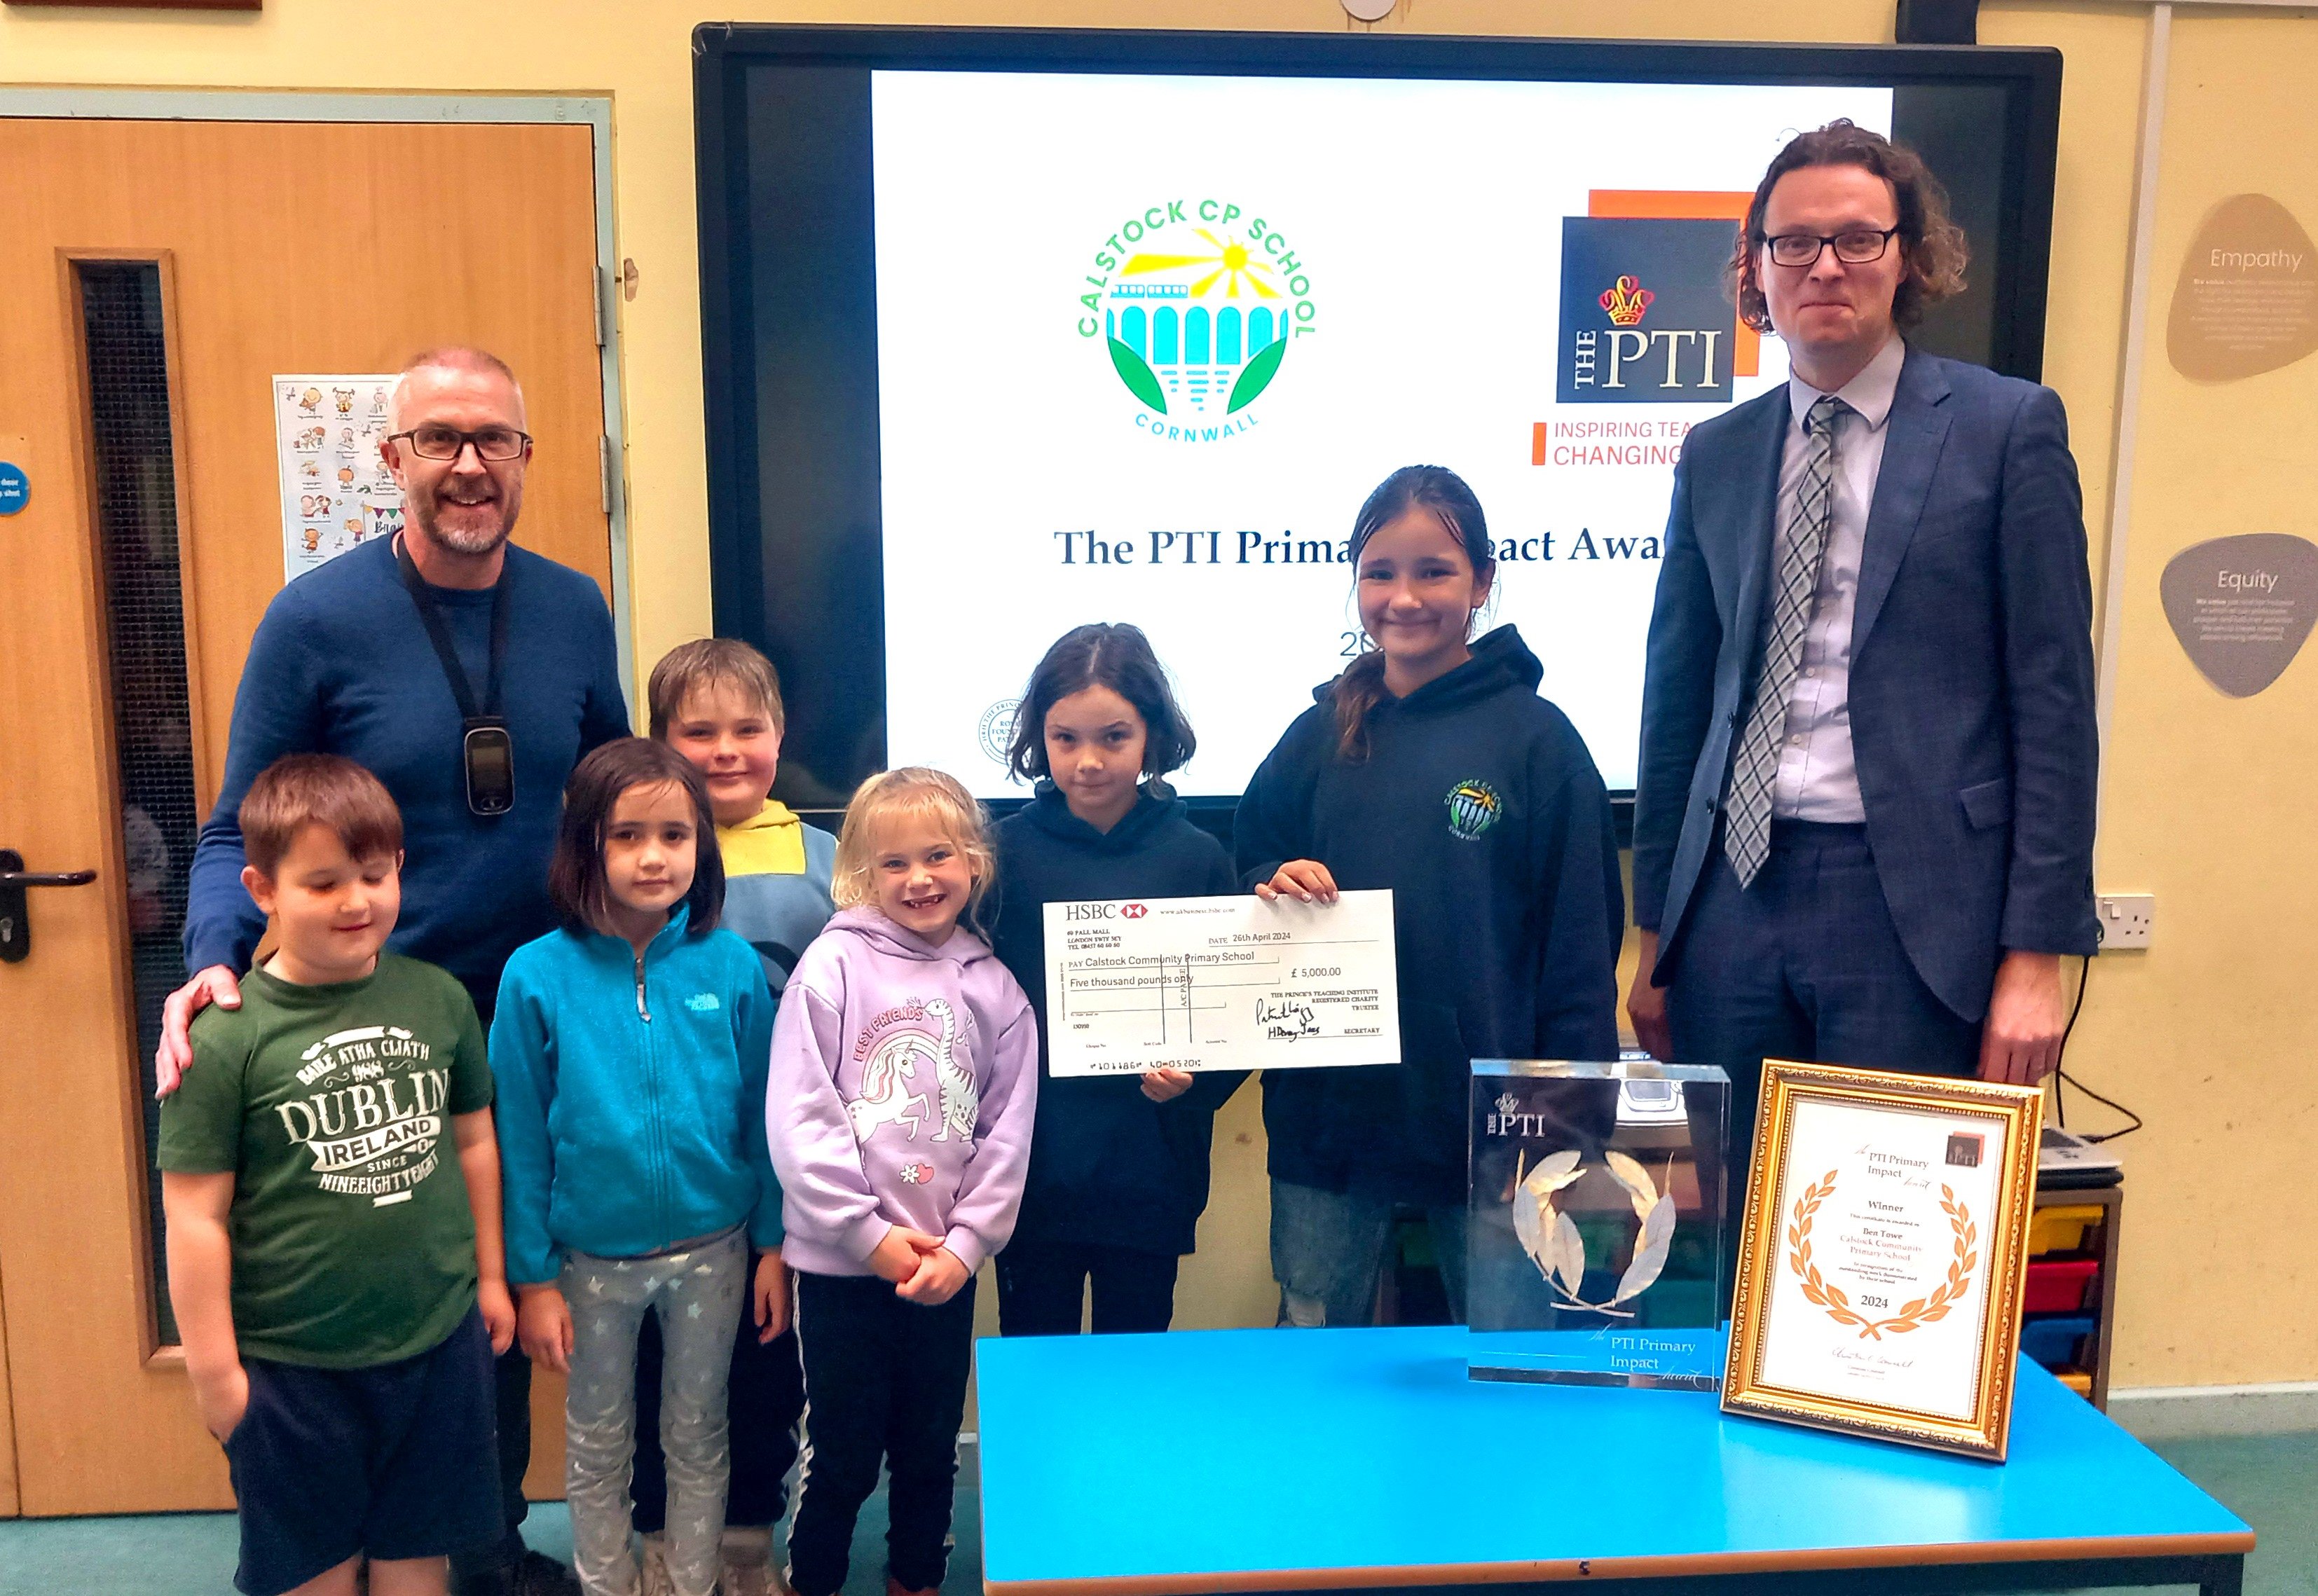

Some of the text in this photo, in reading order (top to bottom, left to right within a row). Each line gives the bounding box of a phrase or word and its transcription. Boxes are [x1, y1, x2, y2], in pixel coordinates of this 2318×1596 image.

[1078, 199, 1315, 338] CALSTOCK CP SCHOOL
[2211, 249, 2303, 273] Empathy
[1574, 330, 1597, 390] THE
[1601, 330, 1722, 388] PTI
[1135, 413, 1259, 443] CORNWALL
[1554, 422, 1652, 438] INSPIRING
[1053, 530, 1134, 564] The
[1148, 531, 1221, 563] PTI
[2217, 570, 2279, 593] Equity
[1065, 903, 1116, 921] HSBC
[1252, 933, 1270, 943] April
[1273, 932, 1291, 940] 2024
[1085, 956, 1125, 967] Calstock
[1128, 954, 1182, 966] Community
[1185, 953, 1220, 964] Primary
[1222, 951, 1254, 961] School
[1070, 979, 1088, 987] Five
[1090, 976, 1134, 986] thousand
[1137, 975, 1171, 986] pounds
[1291, 967, 1341, 979] £ 5,000.00
[853, 1006, 924, 1062] BEST FRIENDS
[295, 1040, 430, 1086] BAILE ATHA CLIATH
[352, 1060, 385, 1082] 988
[275, 1068, 451, 1146] DUBLIN
[1498, 1113, 1545, 1138] PTI
[322, 1120, 431, 1166] IRELAND
[367, 1155, 406, 1172] SINCE
[1870, 1153, 1929, 1170] PTI Primary
[1867, 1166, 1902, 1178] Impact
[1868, 1200, 1904, 1212] Winner
[1863, 1227, 1878, 1237] Ben
[1840, 1234, 1923, 1252] Calstock Community
[1850, 1246, 1911, 1261] Primary School
[1860, 1295, 1888, 1309] 2024
[1612, 1337, 1696, 1356] PTI Primary
[1611, 1355, 1659, 1372] Impact
